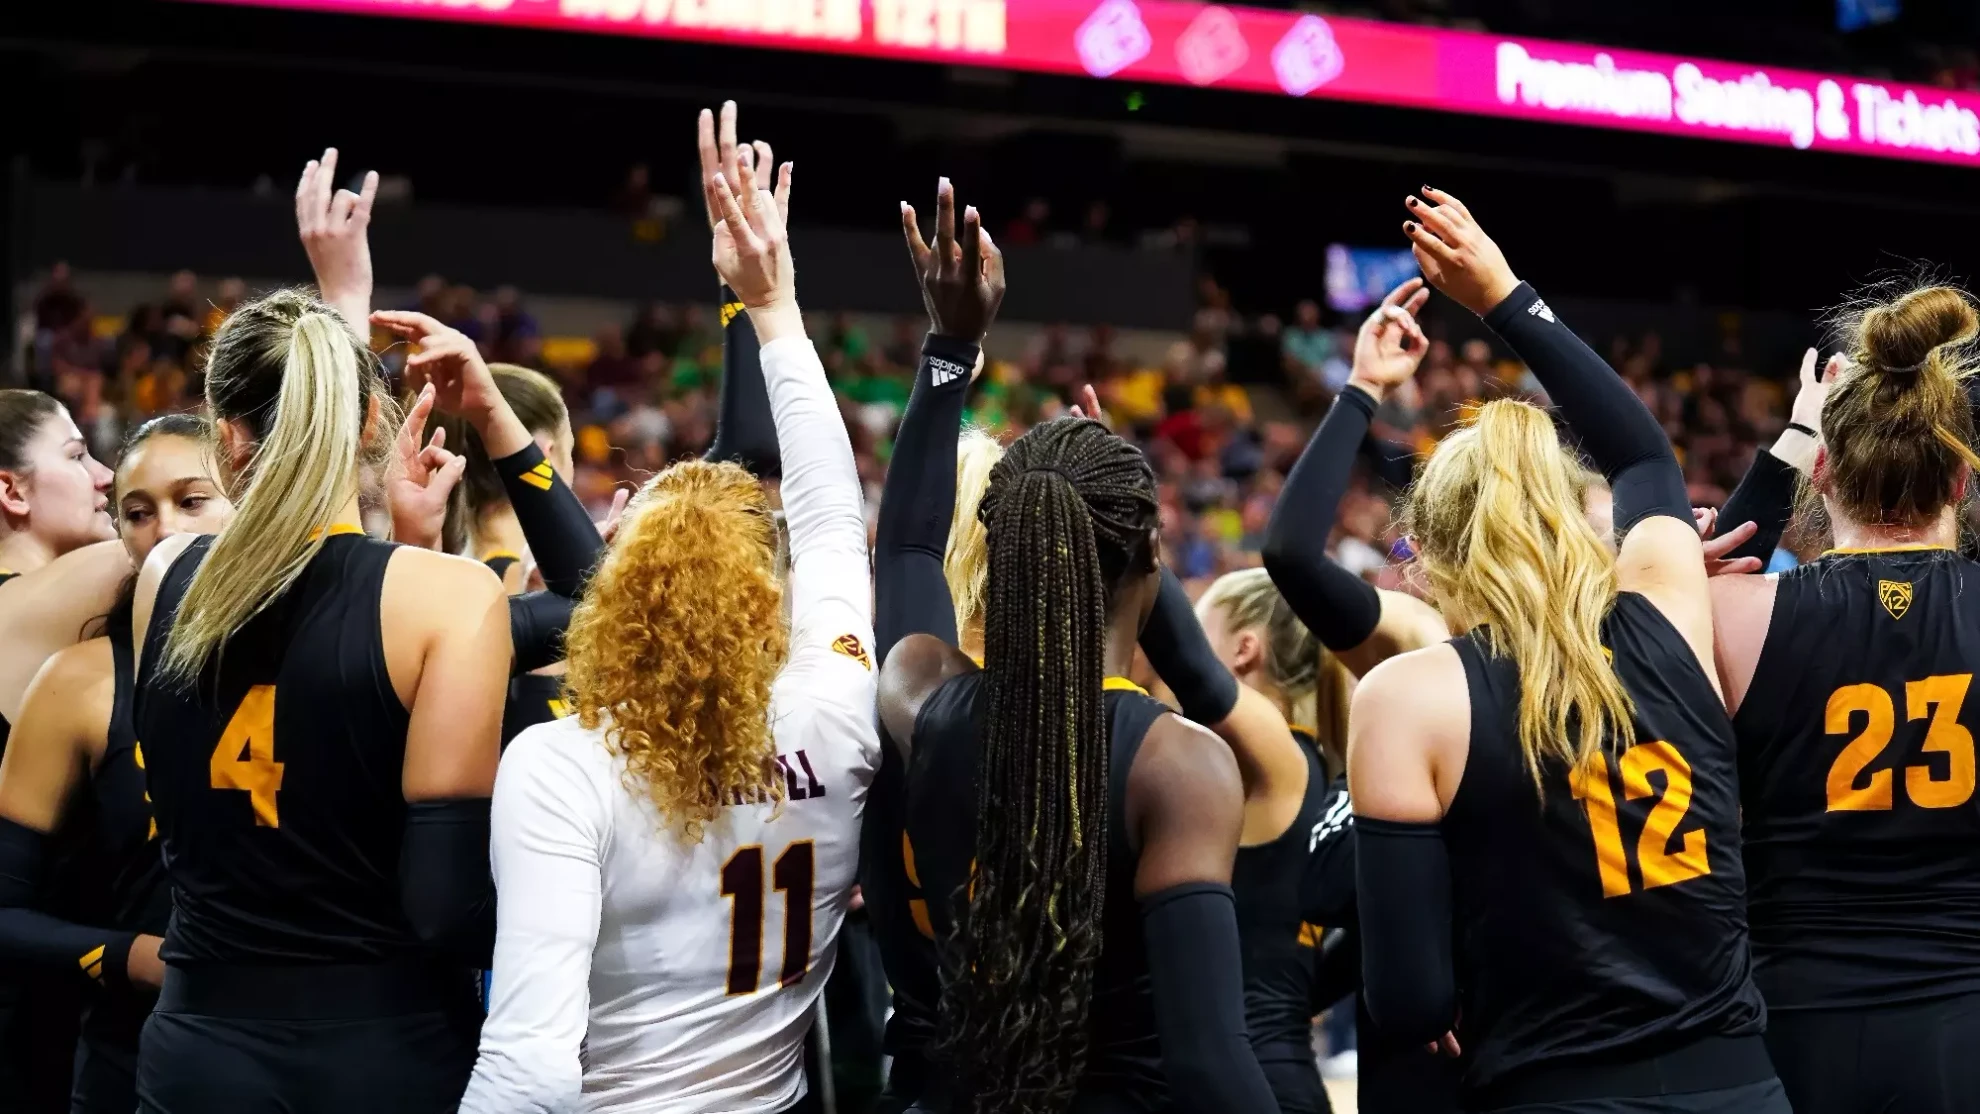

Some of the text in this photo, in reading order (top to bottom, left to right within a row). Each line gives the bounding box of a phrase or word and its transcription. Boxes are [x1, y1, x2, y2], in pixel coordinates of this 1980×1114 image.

[1816, 79, 1850, 140] &
[1853, 83, 1980, 155] Tickets
[929, 356, 964, 375] adidas
[1888, 596, 1906, 610] 12
[210, 685, 285, 828] 4
[1825, 674, 1975, 812] 23
[1568, 740, 1711, 898] 12
[720, 838, 815, 996] 11
